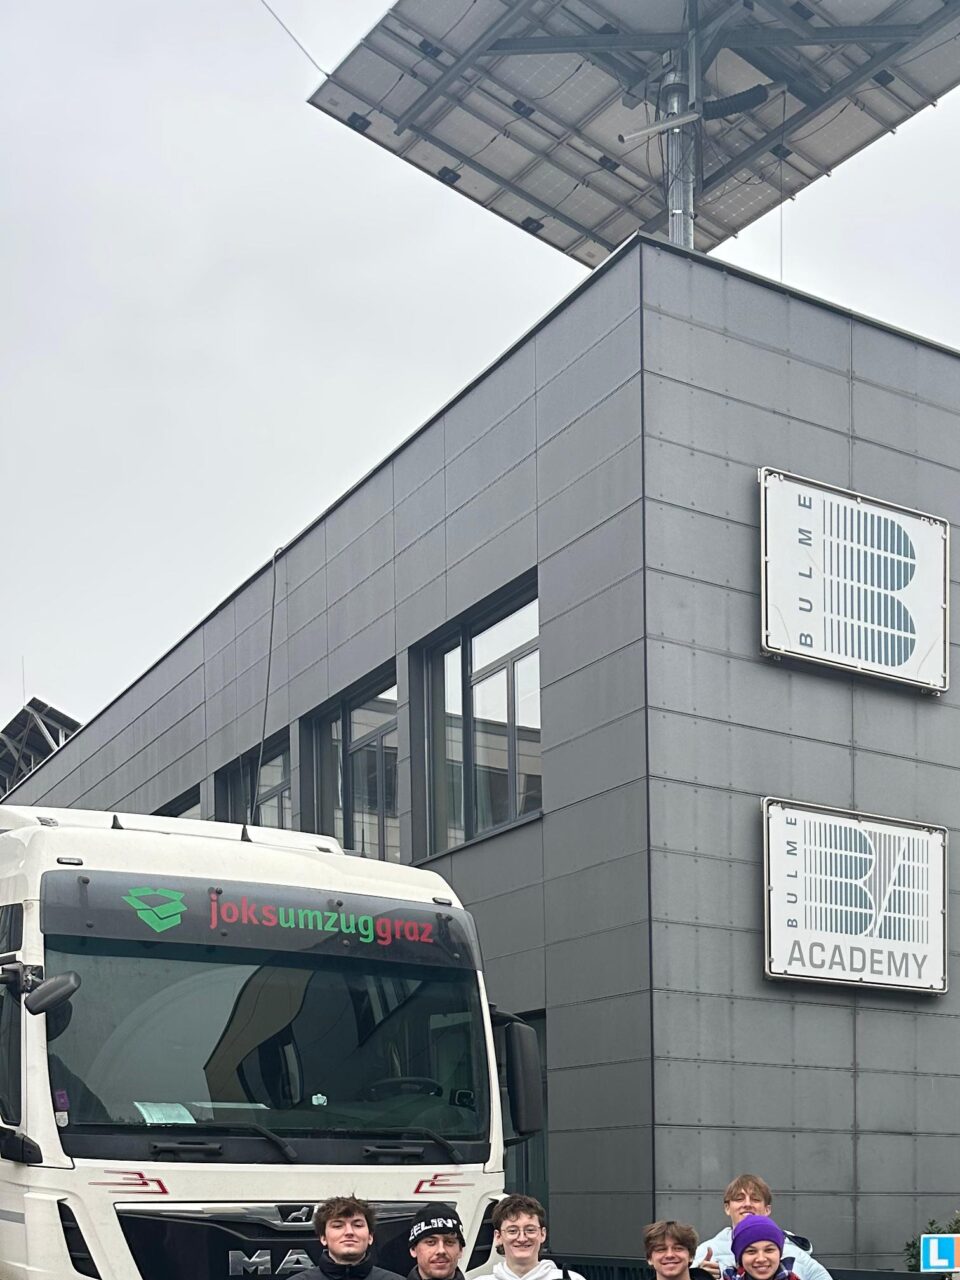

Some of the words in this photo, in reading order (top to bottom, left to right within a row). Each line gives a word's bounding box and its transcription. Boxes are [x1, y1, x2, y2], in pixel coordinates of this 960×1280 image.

[798, 494, 813, 648] BULME
[786, 817, 798, 928] BULME
[209, 889, 434, 946] joksumzuggraz
[787, 939, 928, 979] ACADEMY
[229, 1249, 318, 1276] MA
[929, 1239, 949, 1267] L
